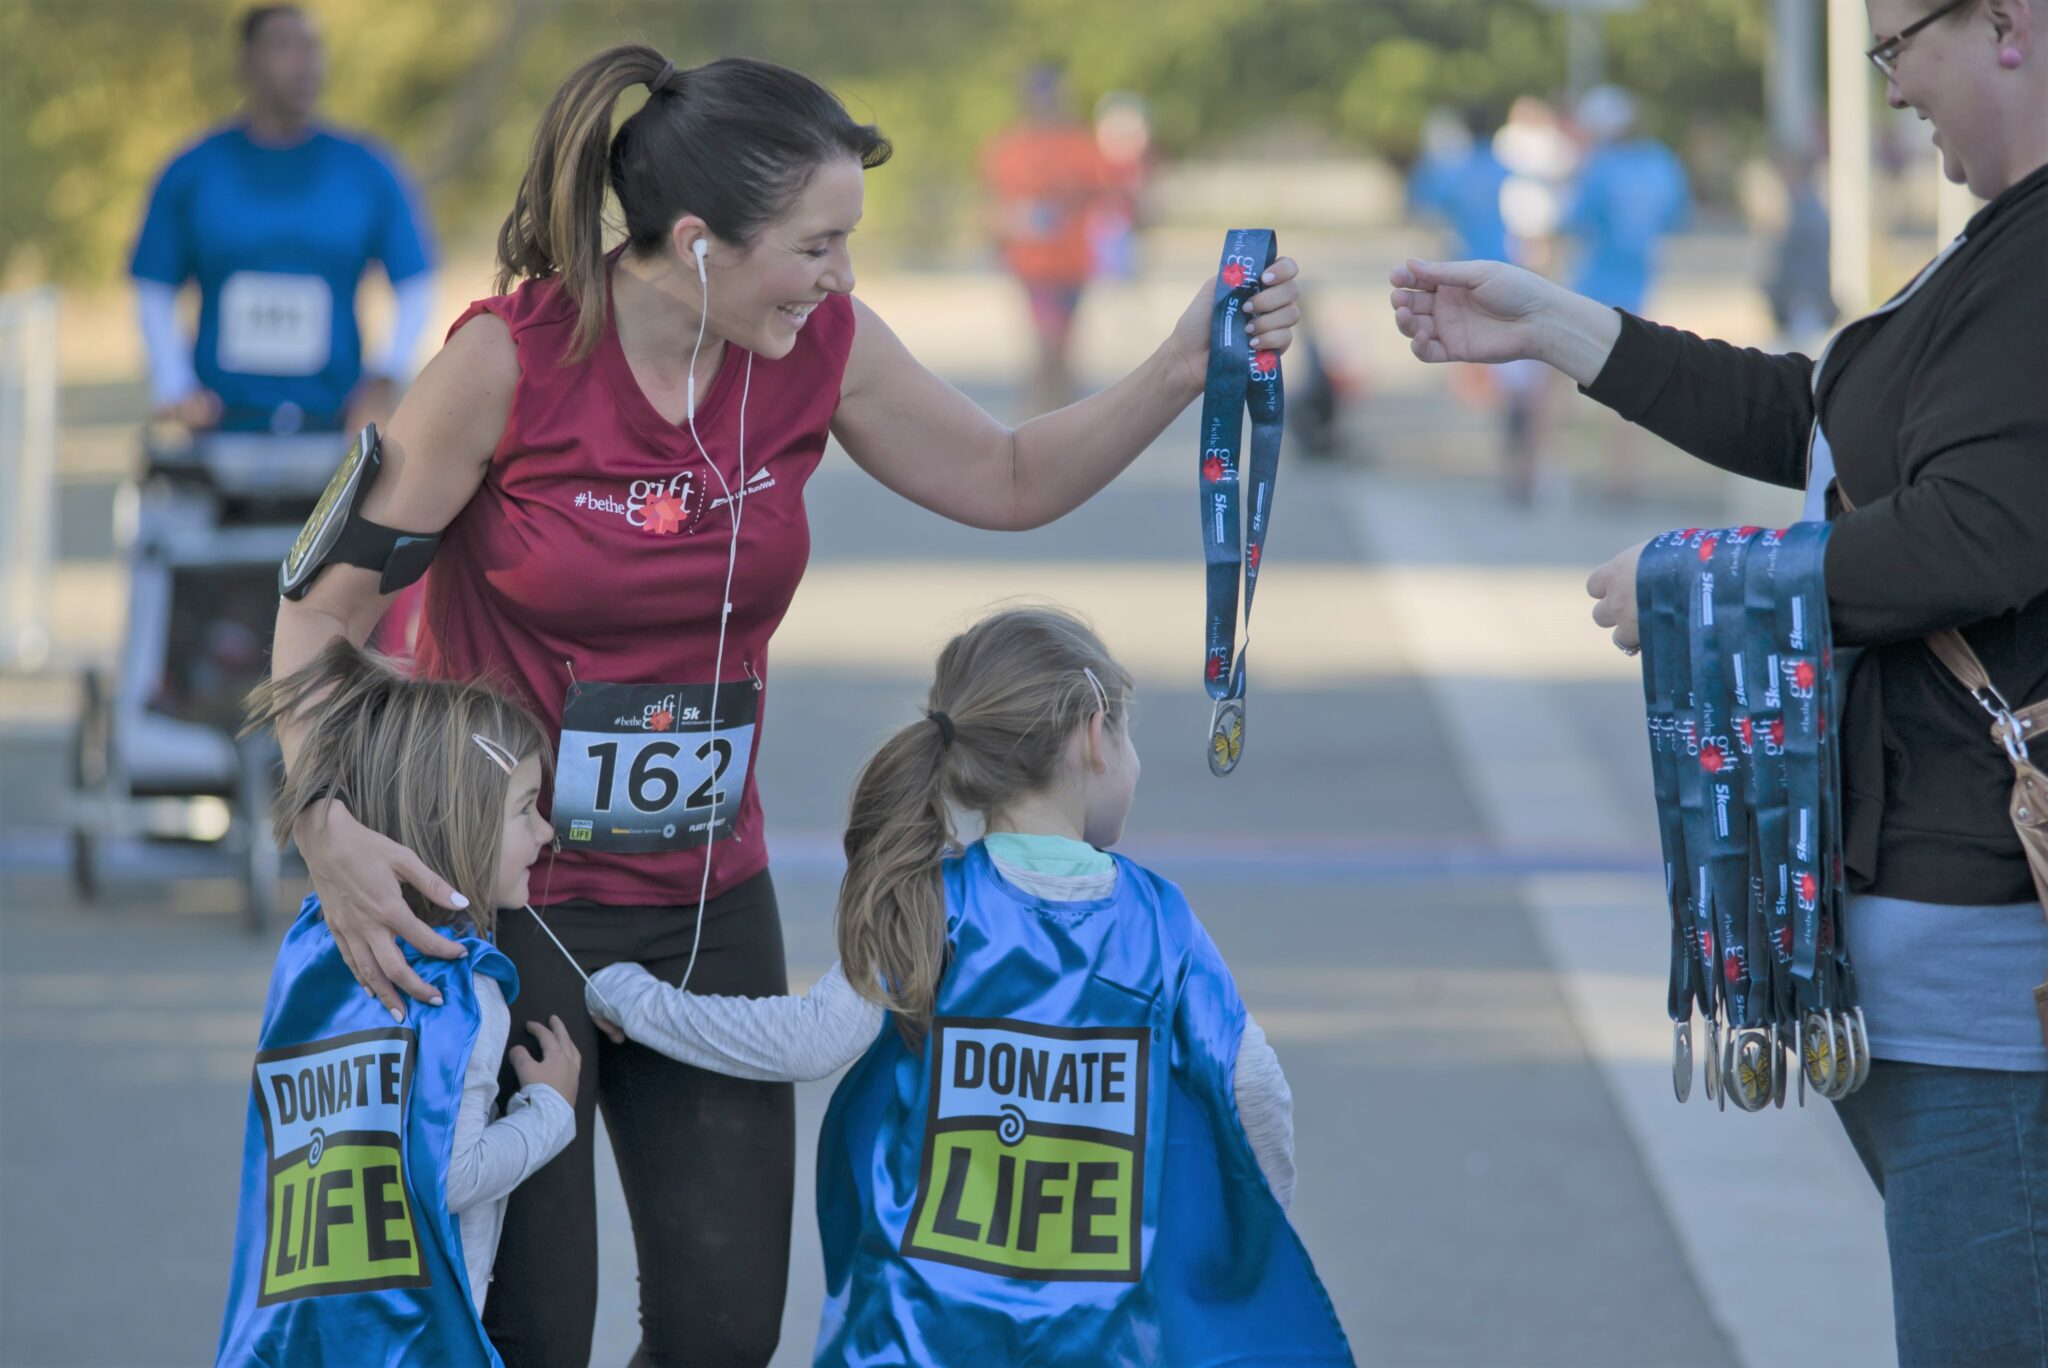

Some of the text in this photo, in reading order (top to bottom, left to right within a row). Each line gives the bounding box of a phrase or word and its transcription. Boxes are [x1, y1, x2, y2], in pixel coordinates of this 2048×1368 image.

[1226, 297, 1239, 318] 5k
[1206, 448, 1240, 483] gift
[574, 471, 695, 527] #bethe gift
[1214, 492, 1228, 513] 5k
[1253, 513, 1263, 531] 5k
[1702, 572, 1714, 593] 5k
[1789, 629, 1803, 650] 5k
[1781, 658, 1814, 699] gift
[614, 716, 643, 728] #bethe
[642, 694, 675, 730] gift
[682, 706, 701, 720] 5k
[1734, 687, 1748, 706] 5k
[1765, 686, 1781, 708] 5k
[1701, 735, 1739, 773] gift
[1752, 717, 1785, 756] gift
[587, 738, 733, 813] 162
[1716, 784, 1730, 805] 5k
[571, 829, 591, 840] LIFE
[1797, 841, 1808, 862] 5k
[1776, 895, 1788, 915] 5k
[1791, 871, 1815, 912] gift
[953, 1040, 1126, 1103] DONATE
[270, 1053, 400, 1126] DONATE
[931, 1146, 1119, 1254] LIFE
[275, 1165, 412, 1277] LIFE
